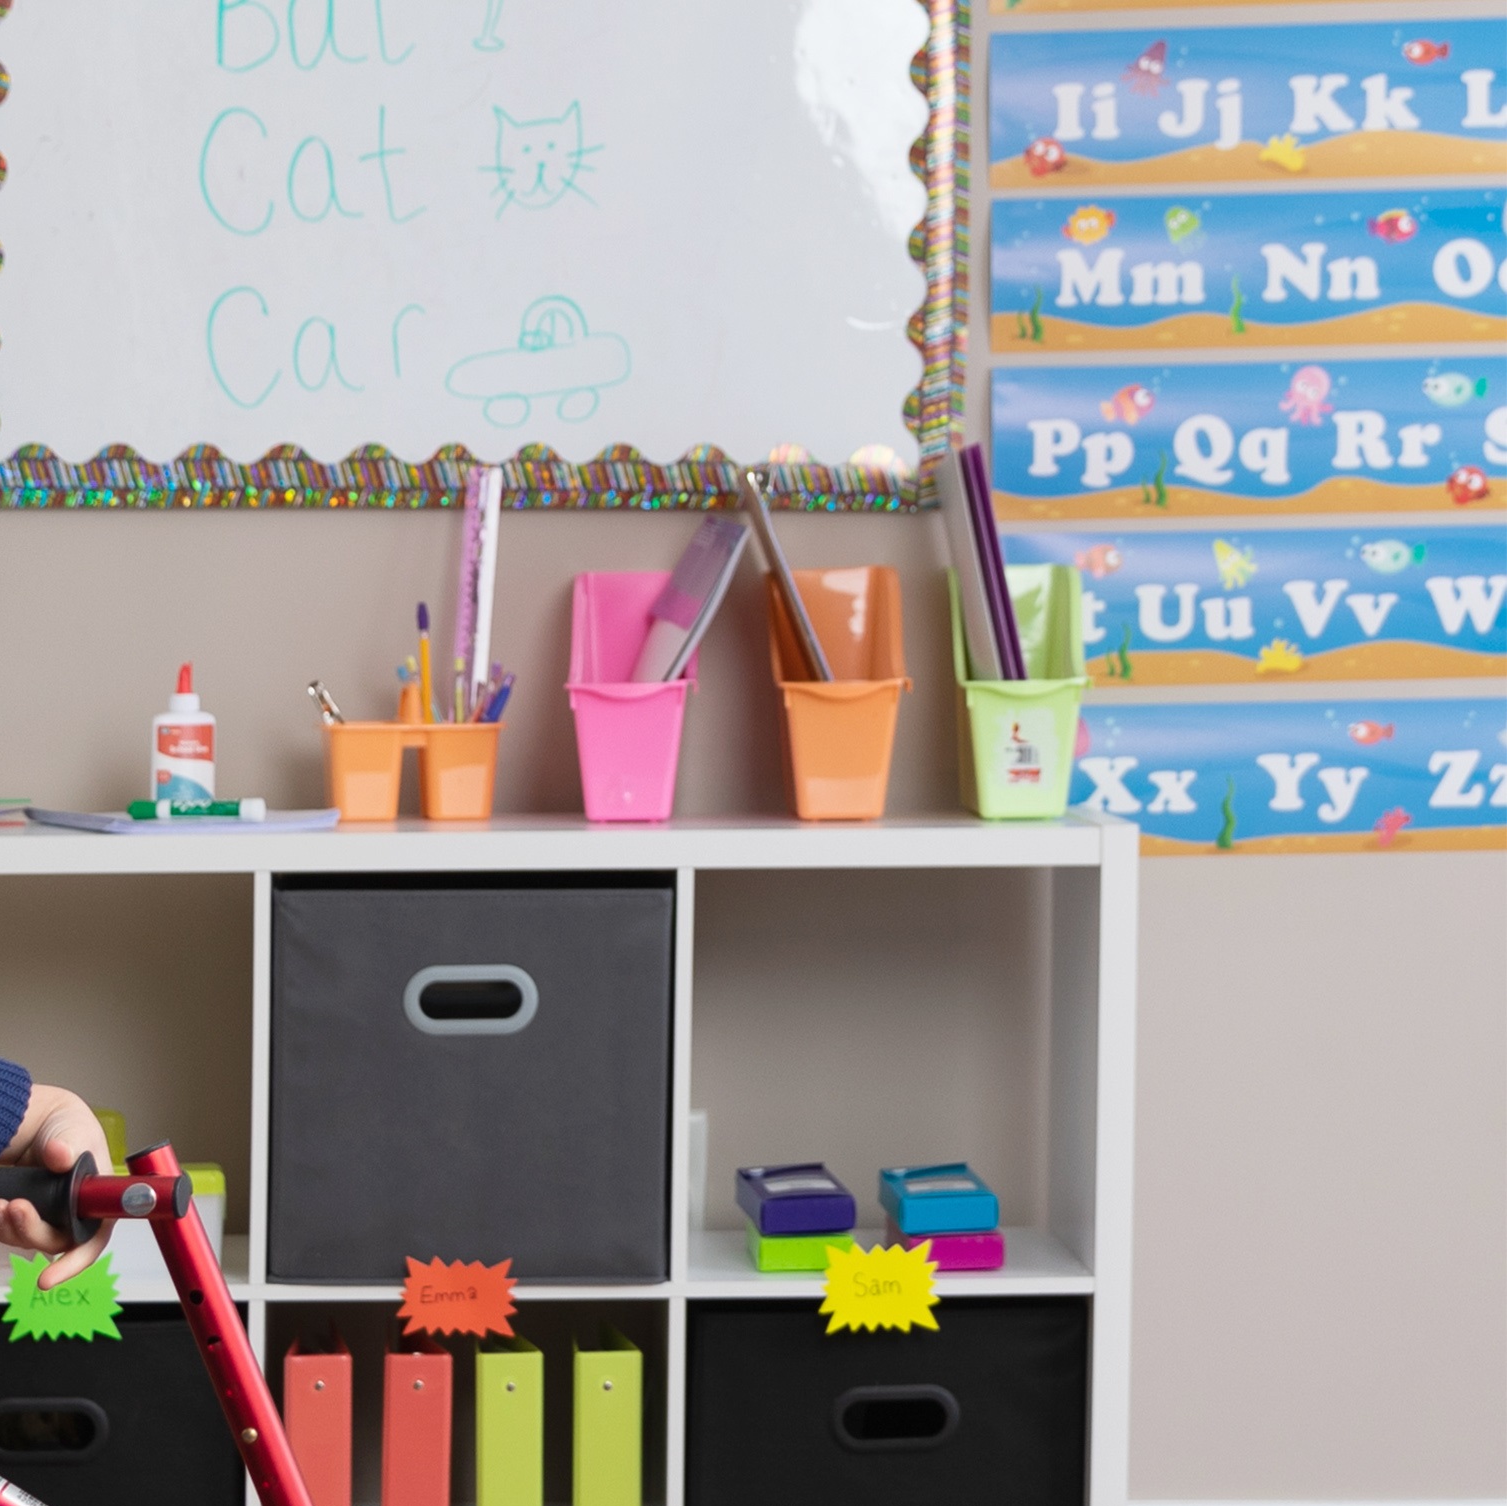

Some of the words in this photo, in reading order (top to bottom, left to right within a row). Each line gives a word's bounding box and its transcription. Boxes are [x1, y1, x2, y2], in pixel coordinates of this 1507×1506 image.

[1053, 81, 1121, 141] Ii
[1158, 77, 1244, 151] Jj
[1289, 73, 1422, 133] Kk
[199, 104, 427, 236] Cat
[1055, 247, 1206, 308] Mm
[1260, 242, 1381, 303] Nn
[1432, 237, 1507, 298] O
[206, 285, 426, 410] Car
[1027, 418, 1135, 488] Pp
[1173, 414, 1291, 485] Qq
[1332, 410, 1442, 469] Rr
[1134, 583, 1255, 643] Uu
[1282, 579, 1398, 639] Vv
[1425, 574, 1507, 635] W
[1078, 755, 1198, 815] Xx
[1255, 752, 1369, 823] Yy
[30, 1284, 91, 1308] Alex
[420, 1284, 478, 1304] Emma
[852, 1270, 902, 1298] Sam
